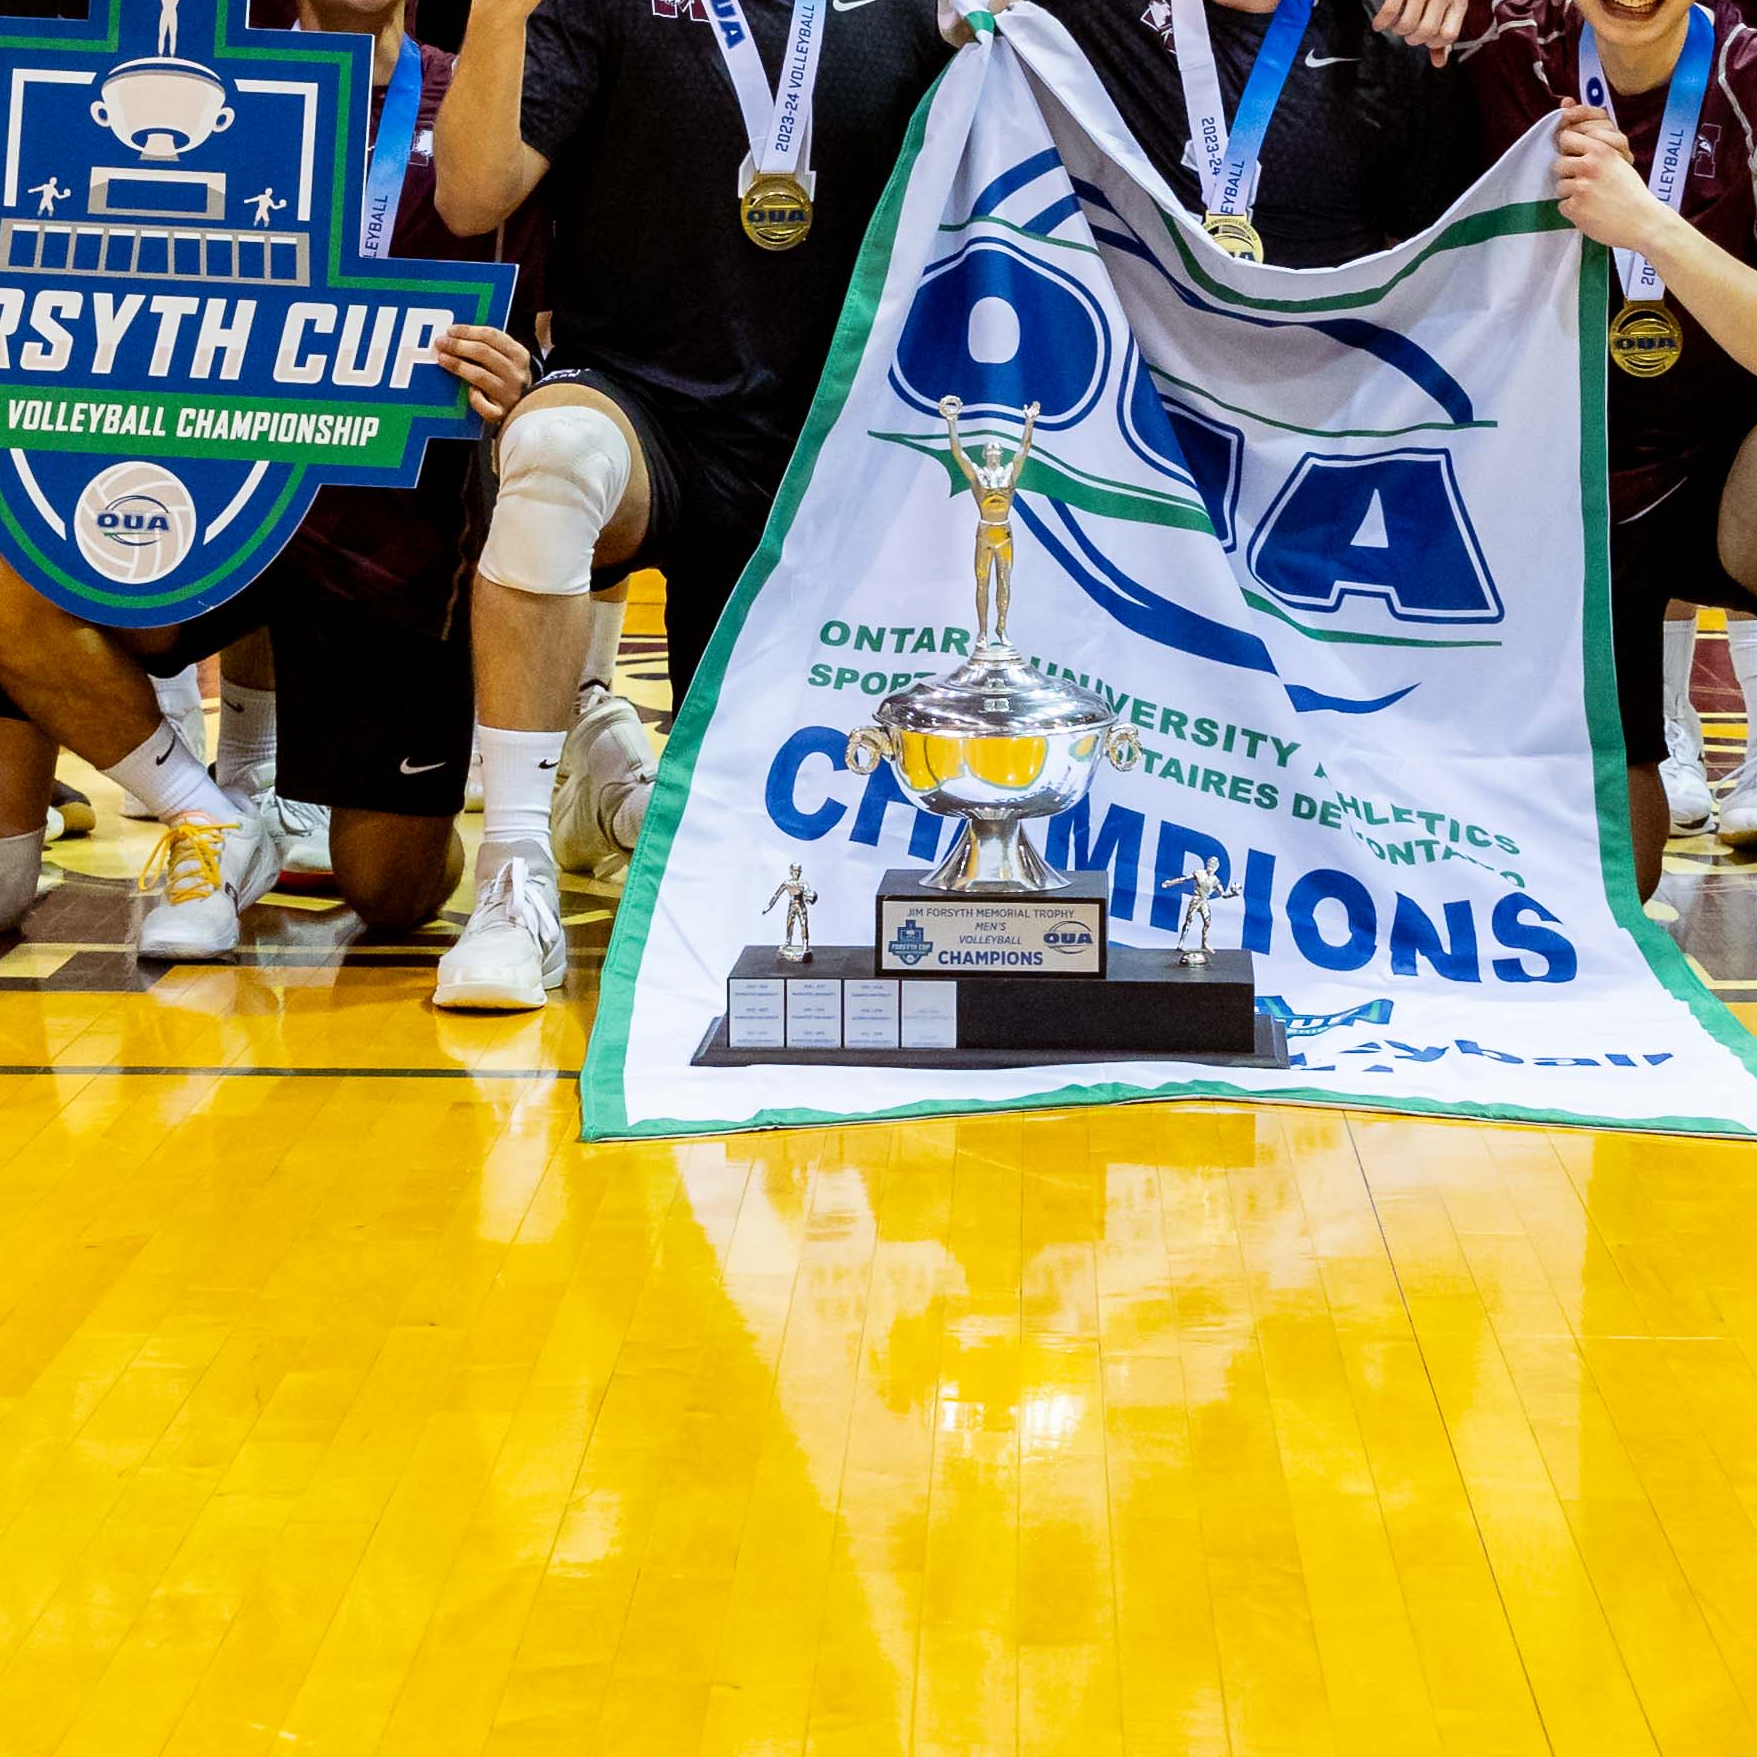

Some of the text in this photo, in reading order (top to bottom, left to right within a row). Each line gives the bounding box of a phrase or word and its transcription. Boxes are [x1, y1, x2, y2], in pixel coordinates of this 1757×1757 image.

[774, 3, 817, 154] 2023-24 VOLLEYBALL
[1200, 115, 1223, 177] 2023-24
[1660, 127, 1685, 206] LLEYBALL
[1220, 160, 1246, 216] EYBALL
[365, 194, 389, 261] LEYBALL
[745, 207, 809, 228] OUA
[272, 301, 457, 390] CUP
[1615, 336, 1680, 354] OUA
[7, 398, 167, 438] VOLLEYBALL
[176, 407, 381, 447] CHAMPIONSHIP
[96, 511, 170, 534] OUA
[819, 619, 971, 657] ONTAR
[764, 724, 1580, 984] CHMPIONS
[907, 907, 1076, 920] JIM FORSYTH MEMORIAL TROPHY
[974, 922, 1007, 932] MEN'S
[958, 935, 1023, 945] VOLLEYBALL
[1043, 932, 1094, 945] OUA
[937, 950, 1044, 967] CHAMPIONS
